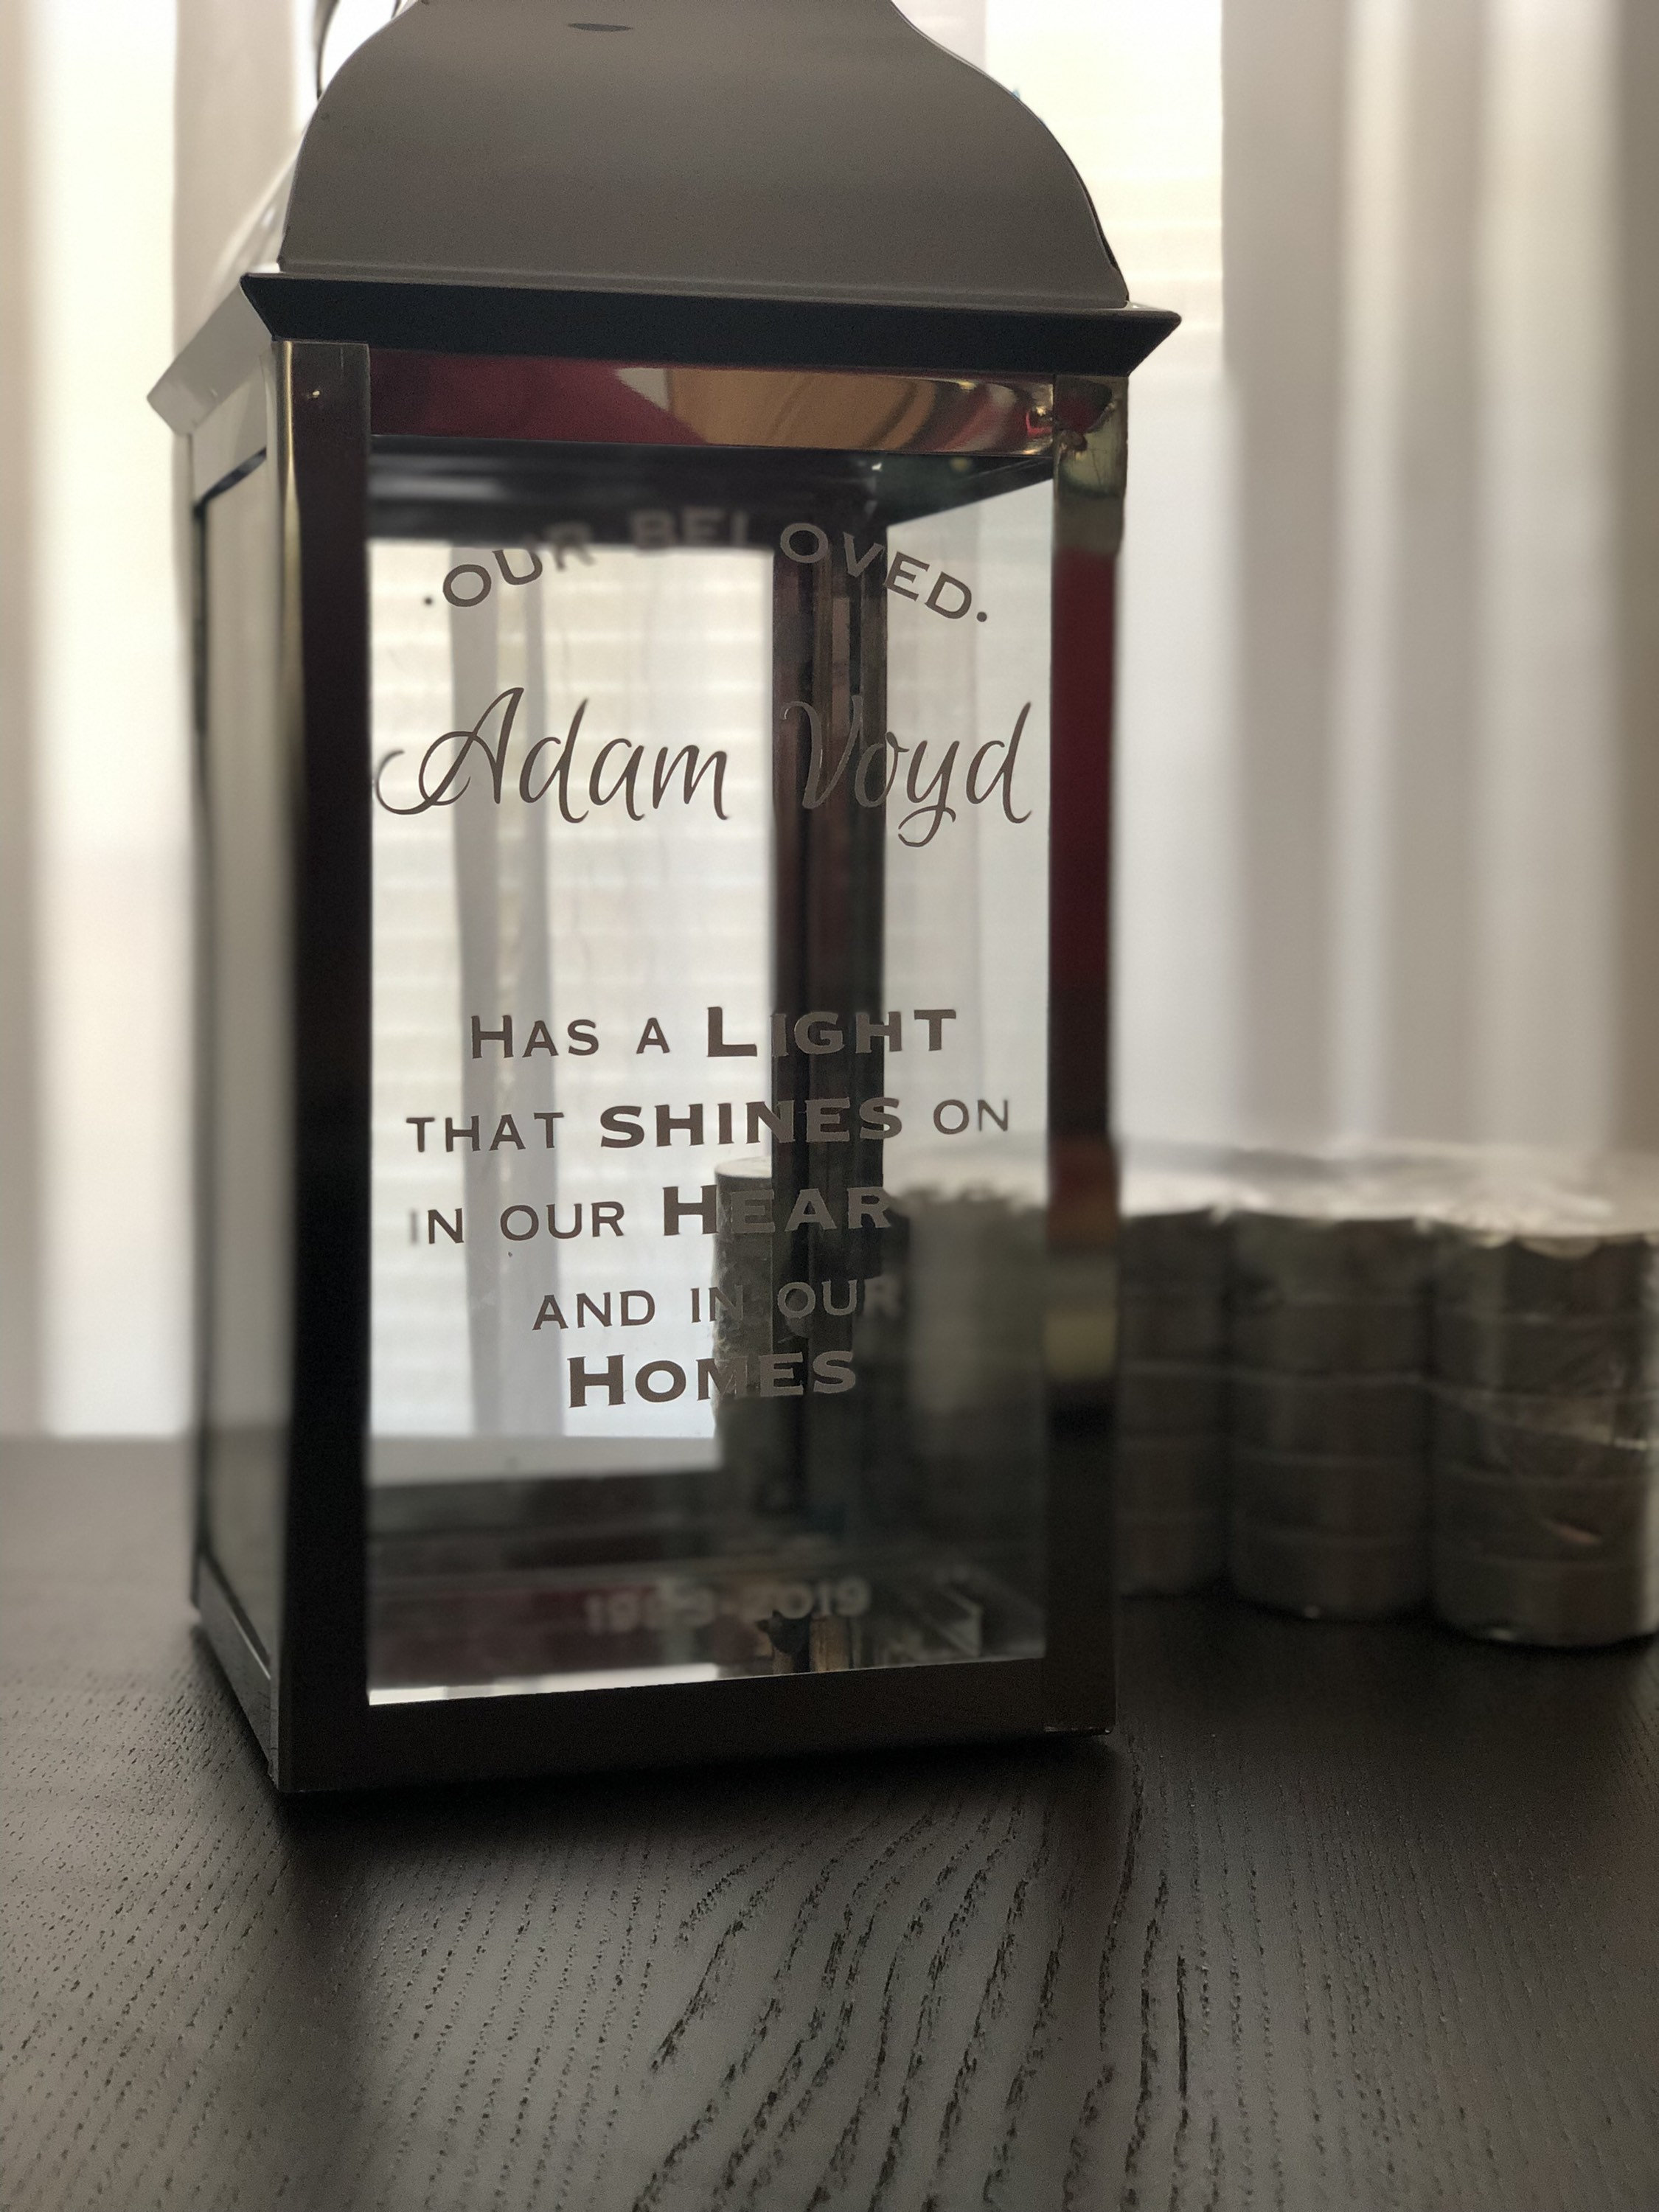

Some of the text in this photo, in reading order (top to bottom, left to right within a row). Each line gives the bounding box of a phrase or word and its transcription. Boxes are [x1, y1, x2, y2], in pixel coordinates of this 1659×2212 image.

[375, 686, 1032, 848] Adam Voyd
[470, 1006, 956, 1060] HAS A LIGHT
[406, 1097, 1009, 1153] THAT SHINES ON
[499, 1201, 626, 1241] OUR
[532, 1290, 655, 1332] AND
[690, 1286, 743, 1324] IN
[568, 1351, 857, 1408] HOMES
